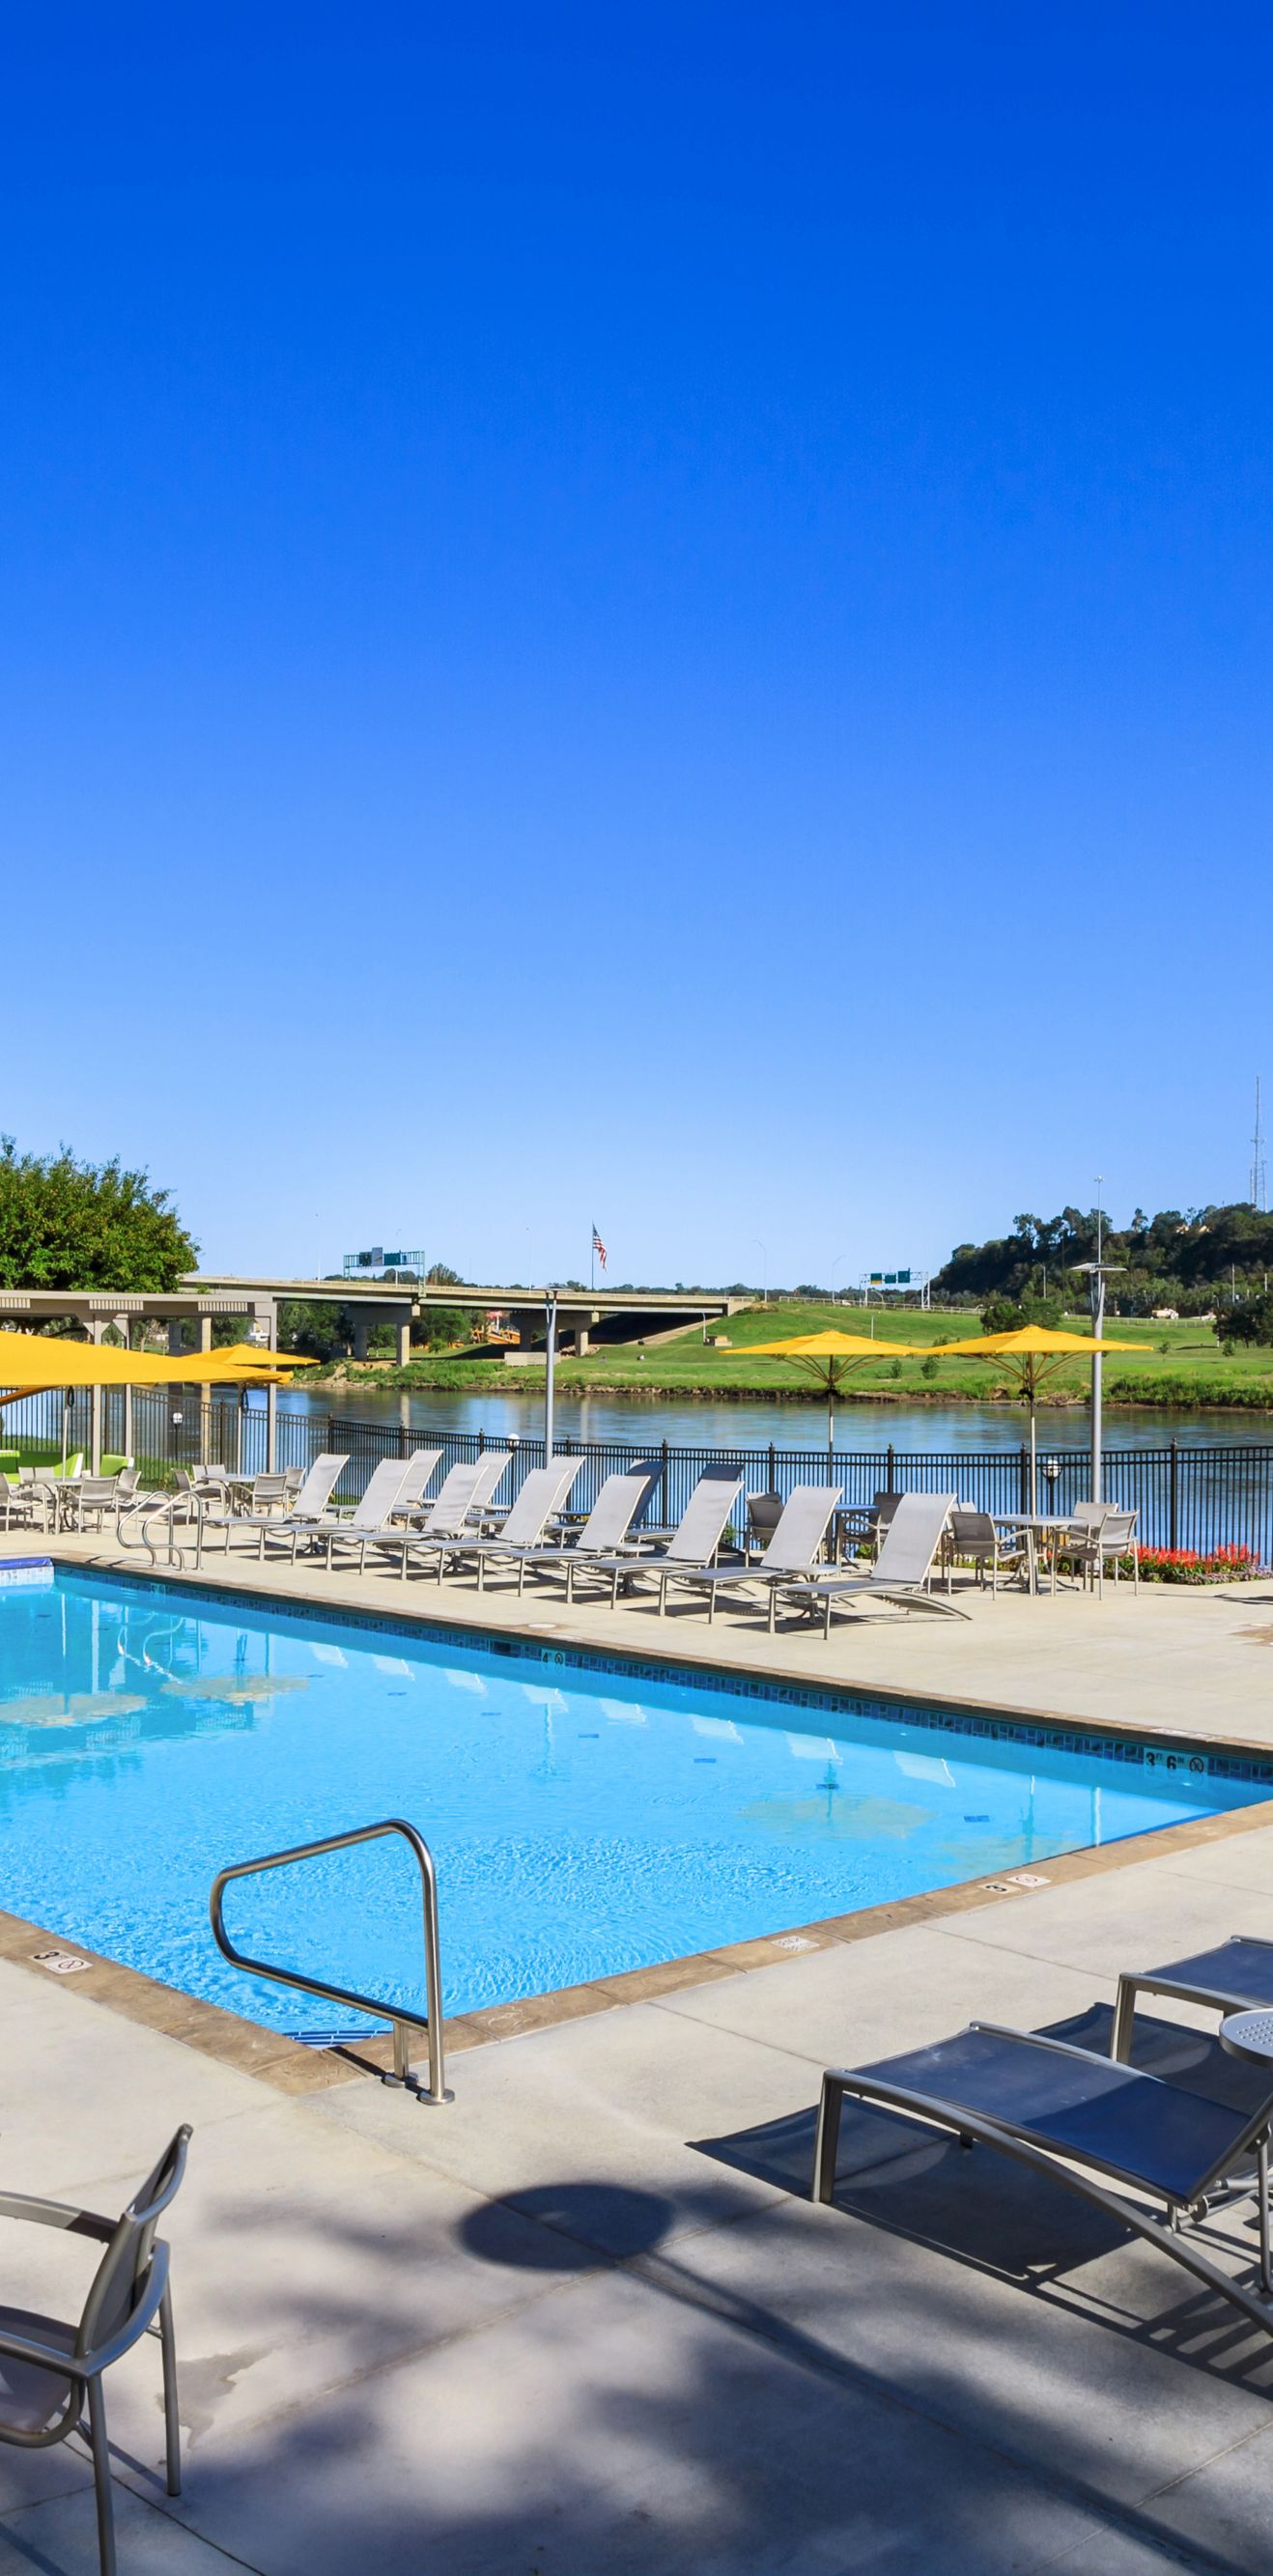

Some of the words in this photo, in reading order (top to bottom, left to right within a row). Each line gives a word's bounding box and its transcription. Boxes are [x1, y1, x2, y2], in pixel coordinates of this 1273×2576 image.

[1146, 1752, 1155, 1767] 3
[1167, 1755, 1176, 1769] 6
[33, 1951, 60, 1960] 3
